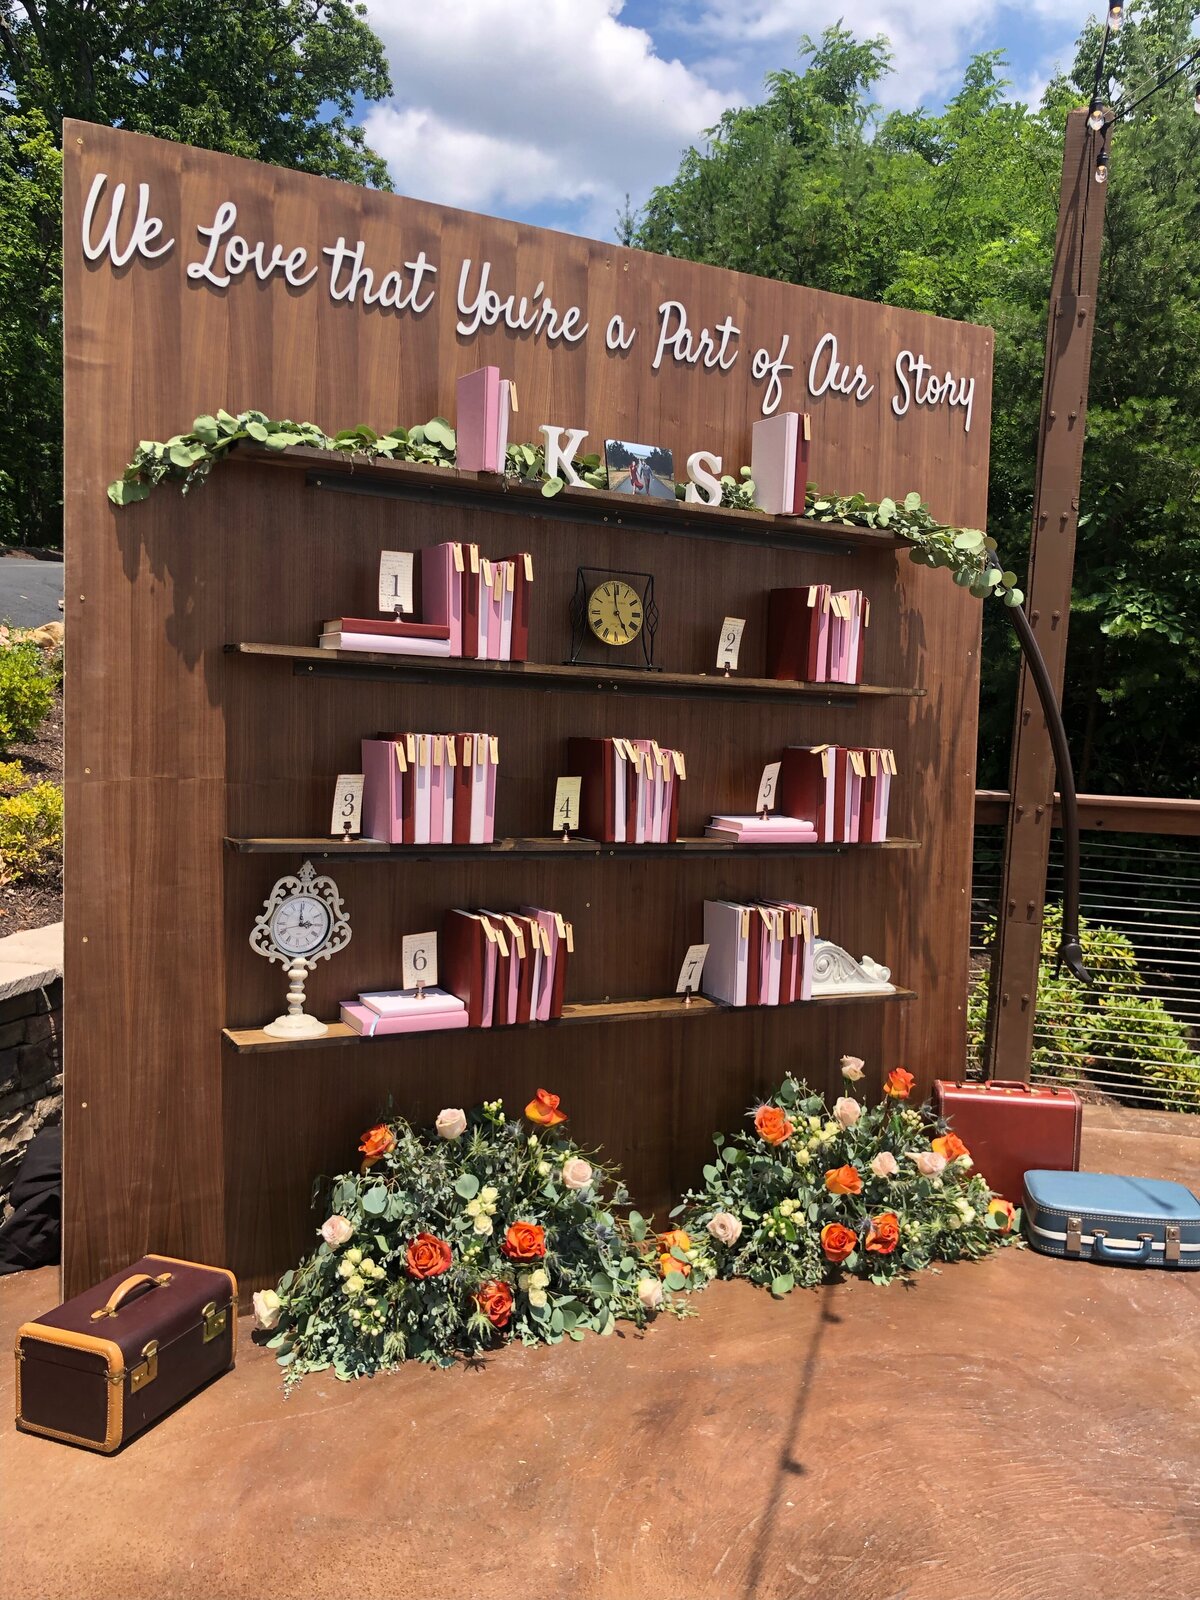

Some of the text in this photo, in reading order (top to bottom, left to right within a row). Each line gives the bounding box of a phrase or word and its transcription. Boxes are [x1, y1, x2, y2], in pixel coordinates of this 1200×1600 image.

[82, 172, 975, 432] We Love that You're a Part of Our Story
[538, 424, 590, 488] K
[685, 450, 723, 507] S
[390, 574, 401, 597] 1
[724, 632, 736, 653] 2
[763, 776, 773, 798] 5
[341, 793, 355, 817] 3
[559, 796, 572, 819] 4
[413, 949, 428, 971] 6
[687, 961, 698, 980] 7
